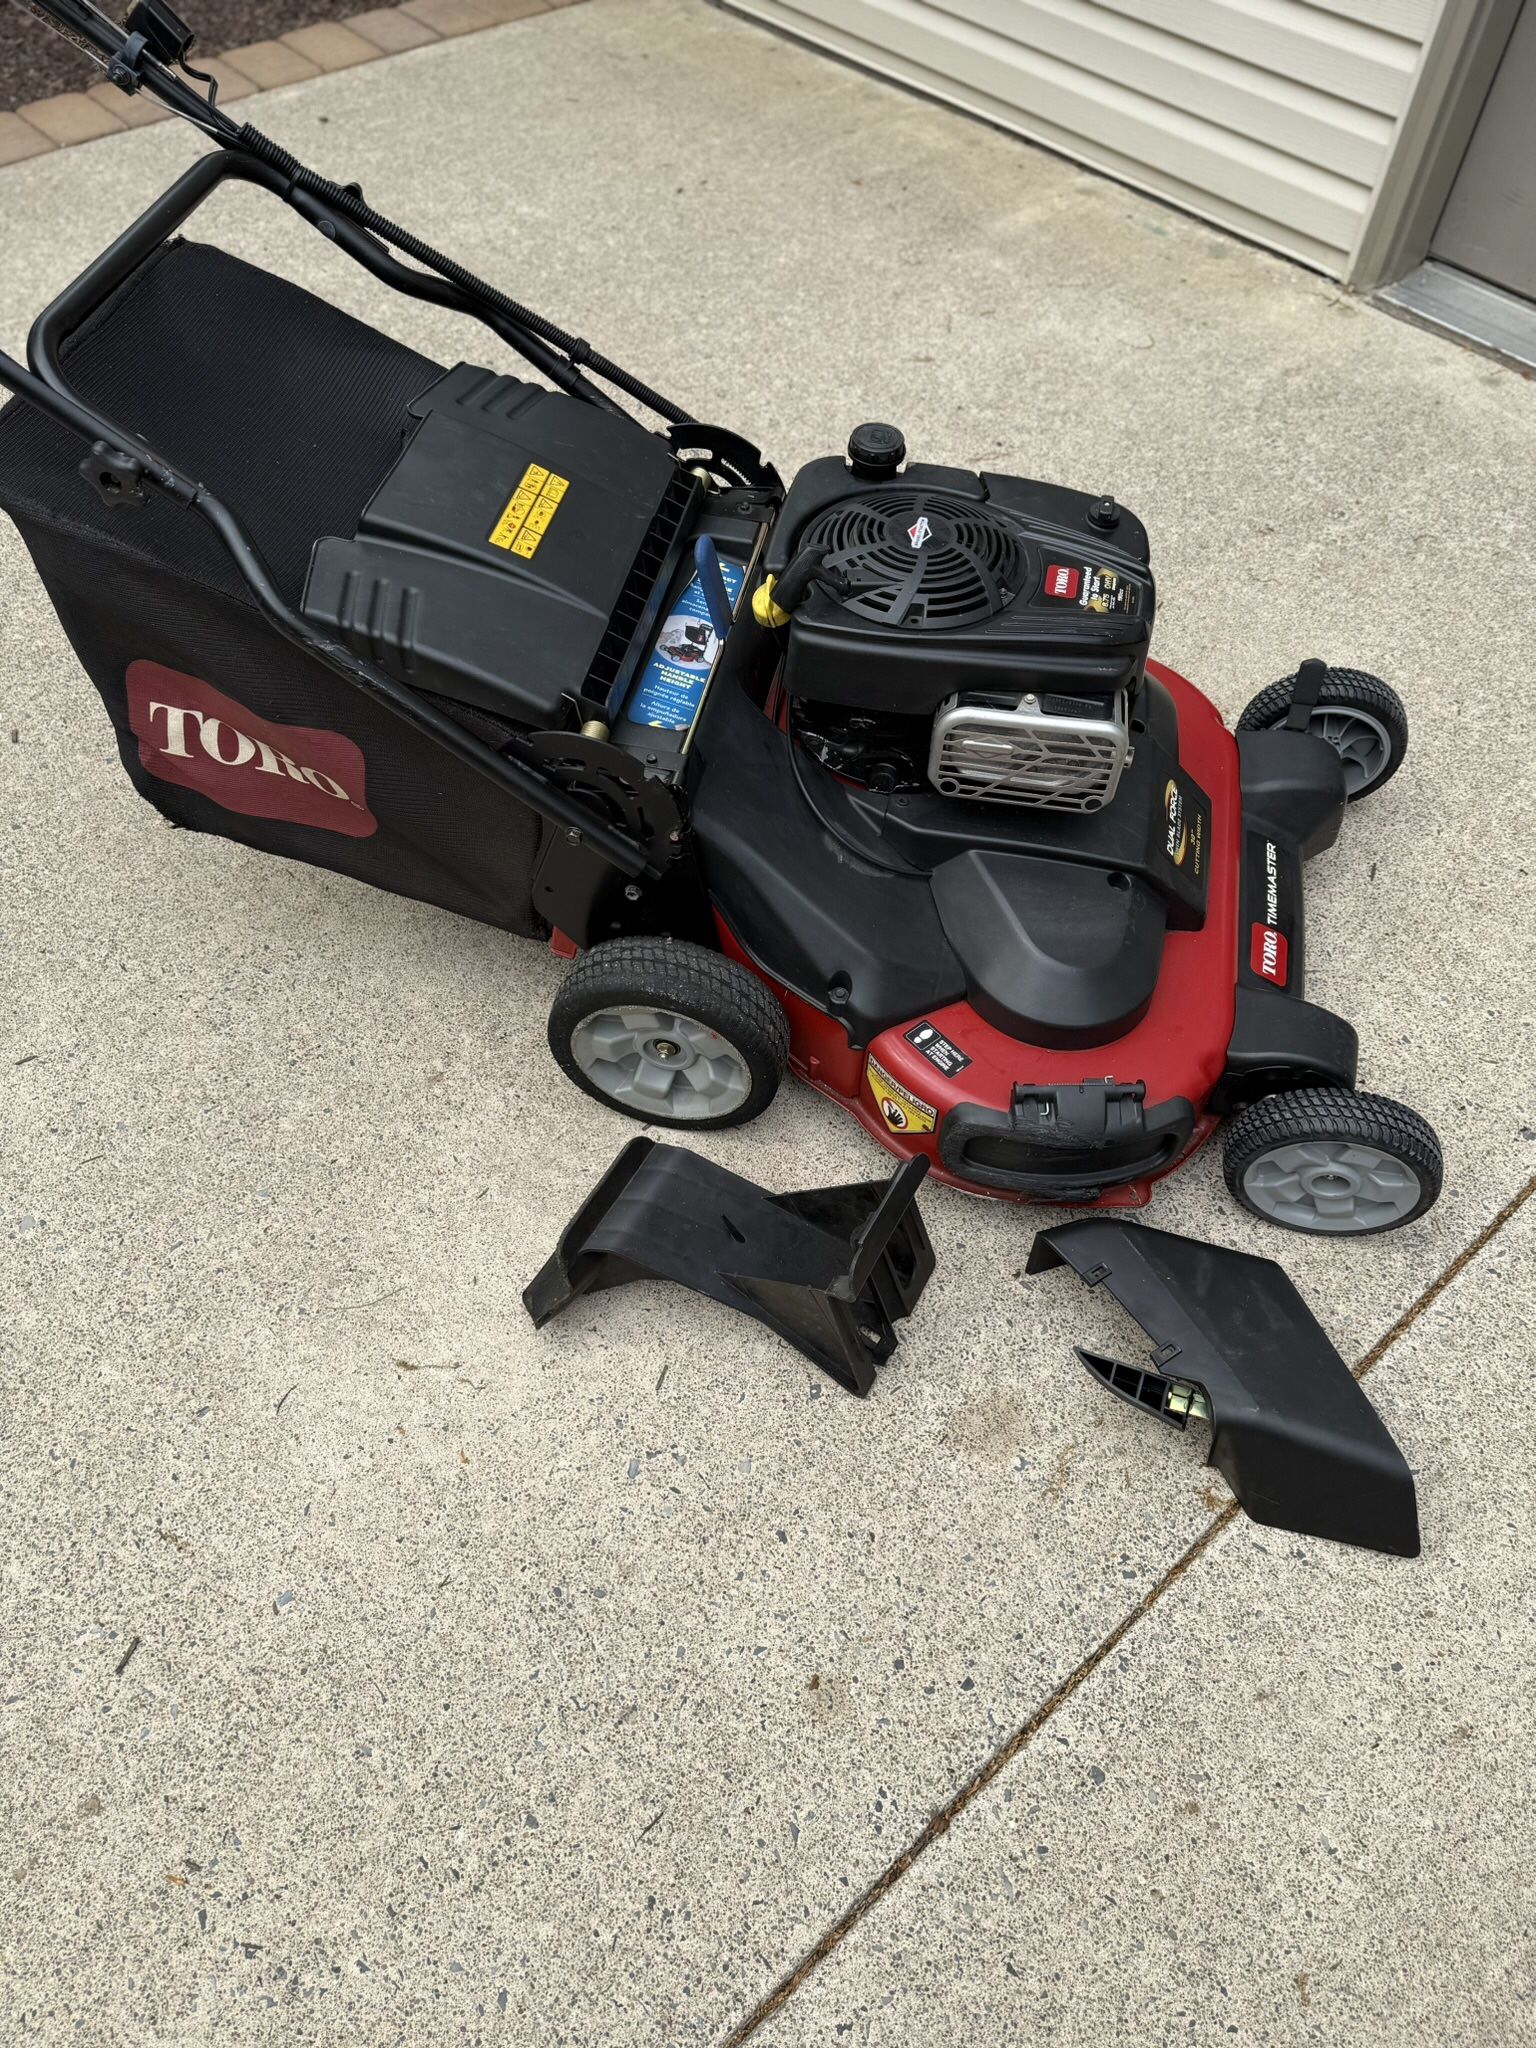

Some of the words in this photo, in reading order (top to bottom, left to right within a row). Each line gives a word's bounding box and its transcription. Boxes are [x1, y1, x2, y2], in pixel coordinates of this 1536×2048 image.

[1054, 568, 1069, 594] TORO
[1079, 566, 1092, 606] Guaranteed
[1090, 576, 1100, 593] Start
[1101, 593, 1110, 608] 8.75
[653, 662, 706, 684] ADJUSTABLE
[659, 676, 692, 690] HEIGHT
[660, 670, 695, 685] HANDLE
[654, 684, 680, 696] Hauteur
[149, 701, 350, 801] TORO
[1169, 785, 1178, 824] FORCE
[1166, 824, 1176, 857] DUAL
[1266, 842, 1278, 926] TIMEMASTER
[1262, 930, 1278, 976] TORO
[939, 1039, 952, 1051] STEP
